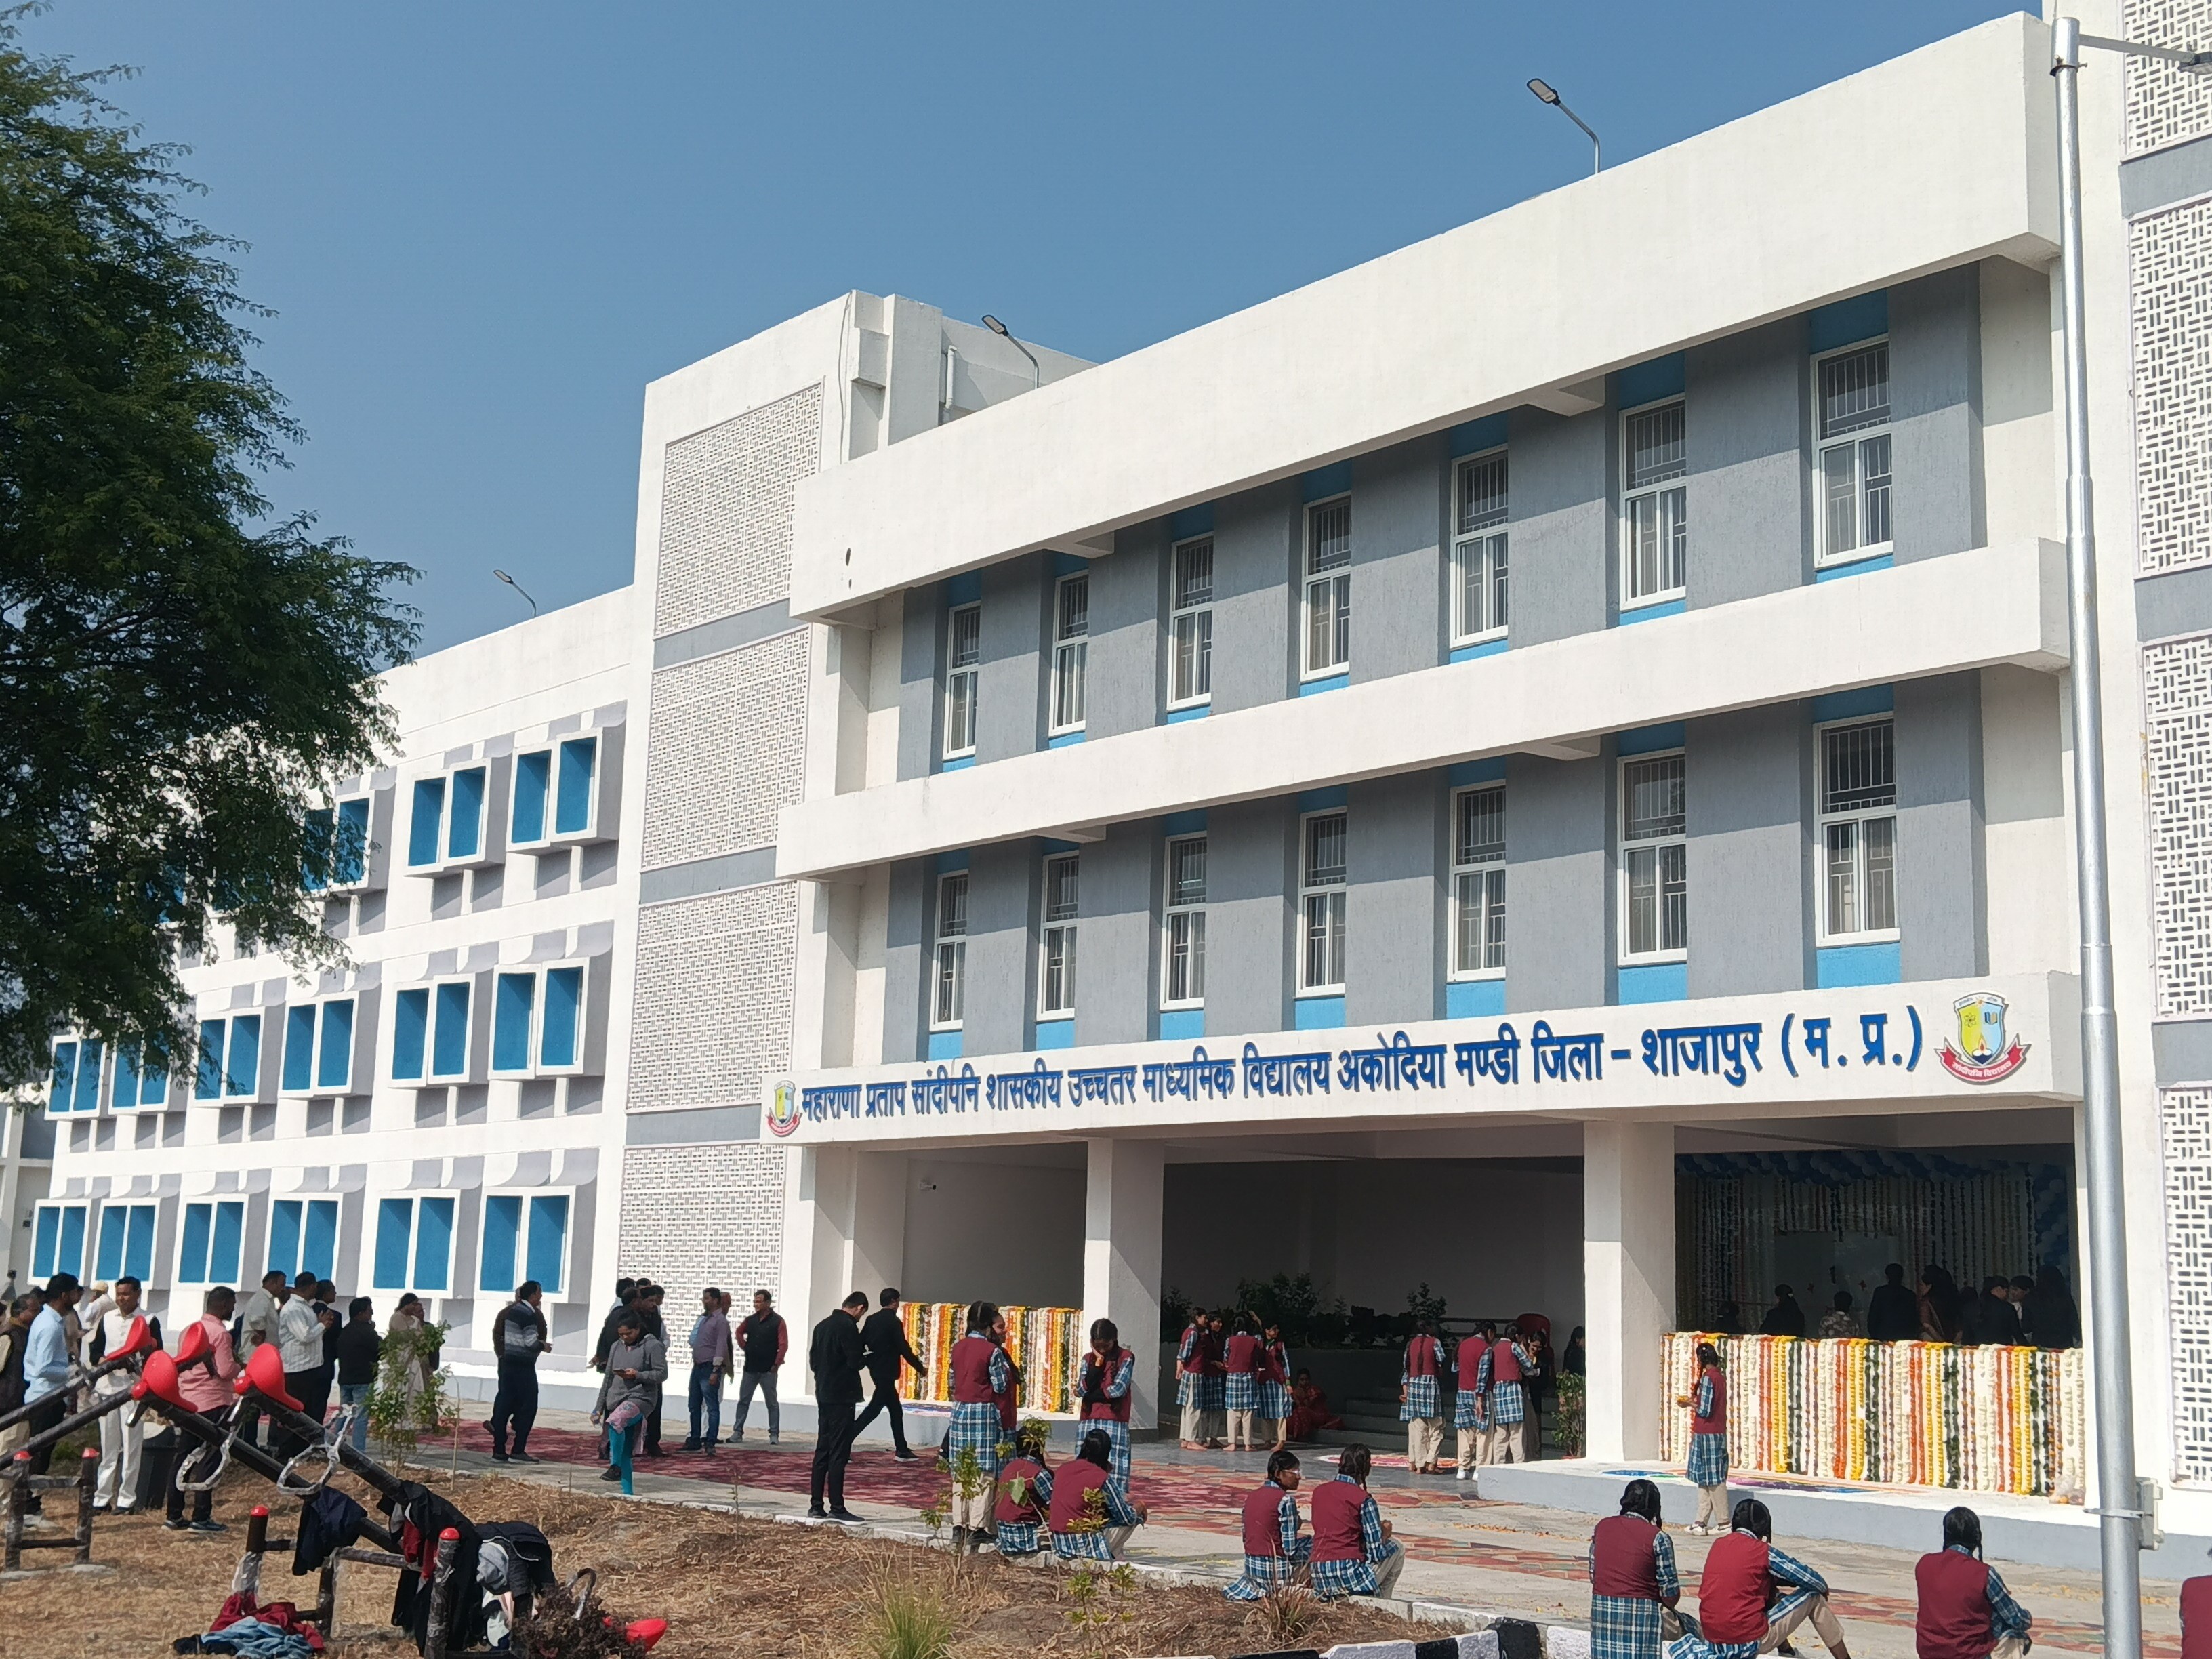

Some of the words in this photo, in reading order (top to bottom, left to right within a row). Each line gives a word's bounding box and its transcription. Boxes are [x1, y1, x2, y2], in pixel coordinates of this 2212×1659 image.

[802, 1085, 862, 1122] महाराणा
[865, 1082, 907, 1117] प्रताप
[911, 1063, 981, 1115] सांदीपनि
[986, 1057, 1063, 1109] शासकीय
[1067, 1065, 1137, 1107] उच्चतर
[1142, 1046, 1236, 1101] माध्यमिक
[1242, 1042, 1332, 1098] विद्यालय
[1337, 1031, 1448, 1092] अकोदिया
[1454, 1022, 1521, 1086] मण्डी
[1531, 1020, 1604, 1083] जिला
[1641, 1023, 1763, 1088] शाजापुर
